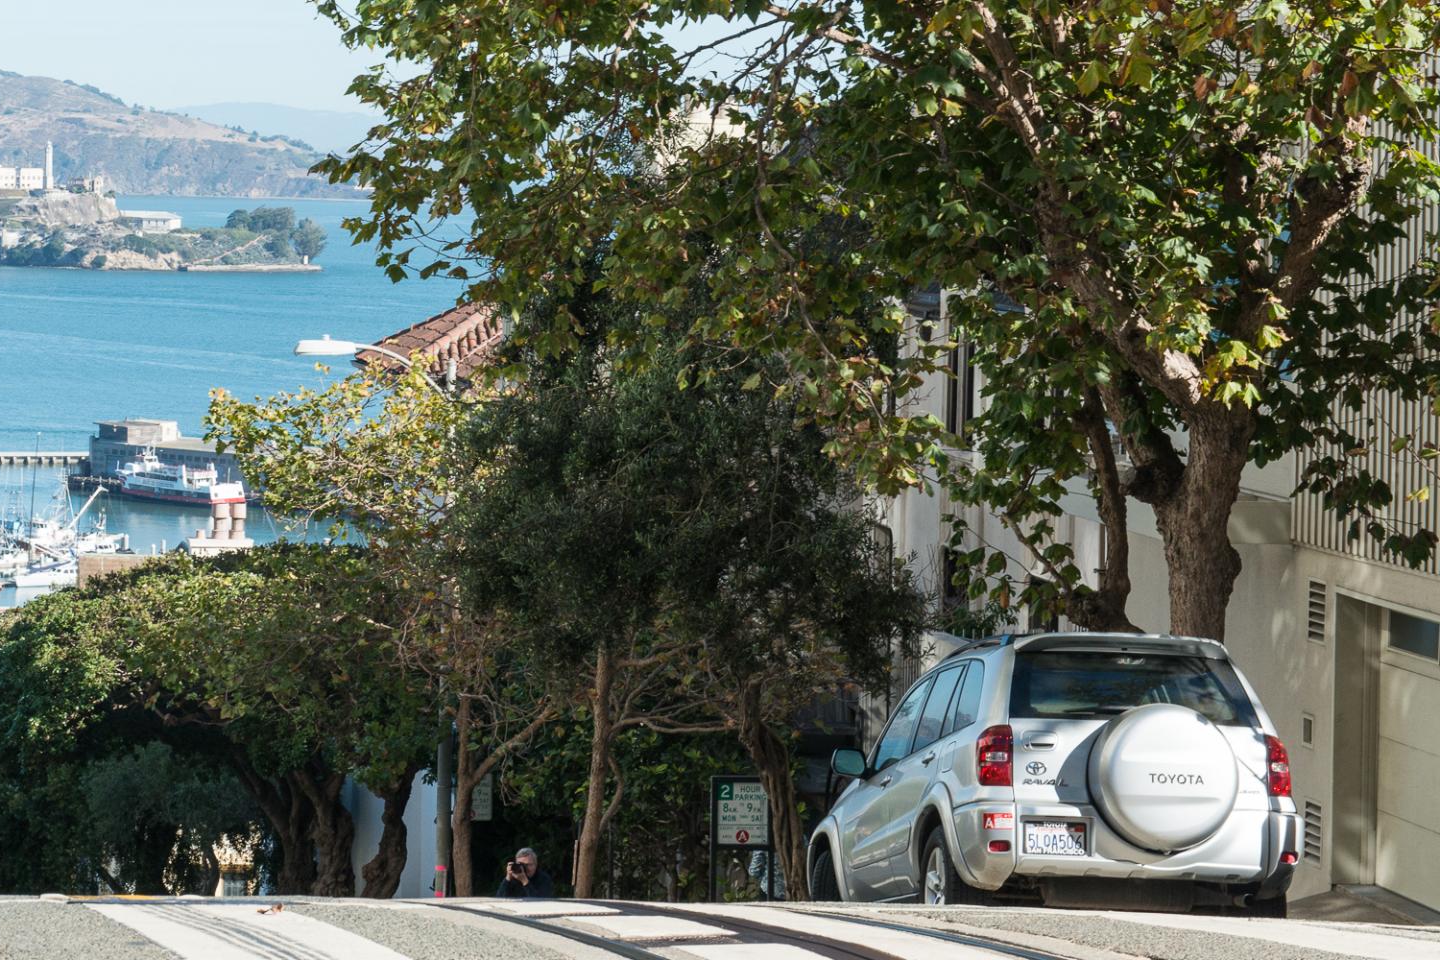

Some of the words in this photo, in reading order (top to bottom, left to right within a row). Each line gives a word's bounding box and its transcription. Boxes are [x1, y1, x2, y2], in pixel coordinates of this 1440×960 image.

[1149, 773, 1205, 785] TOYOTA
[721, 785, 730, 797] 2
[985, 817, 994, 829] A
